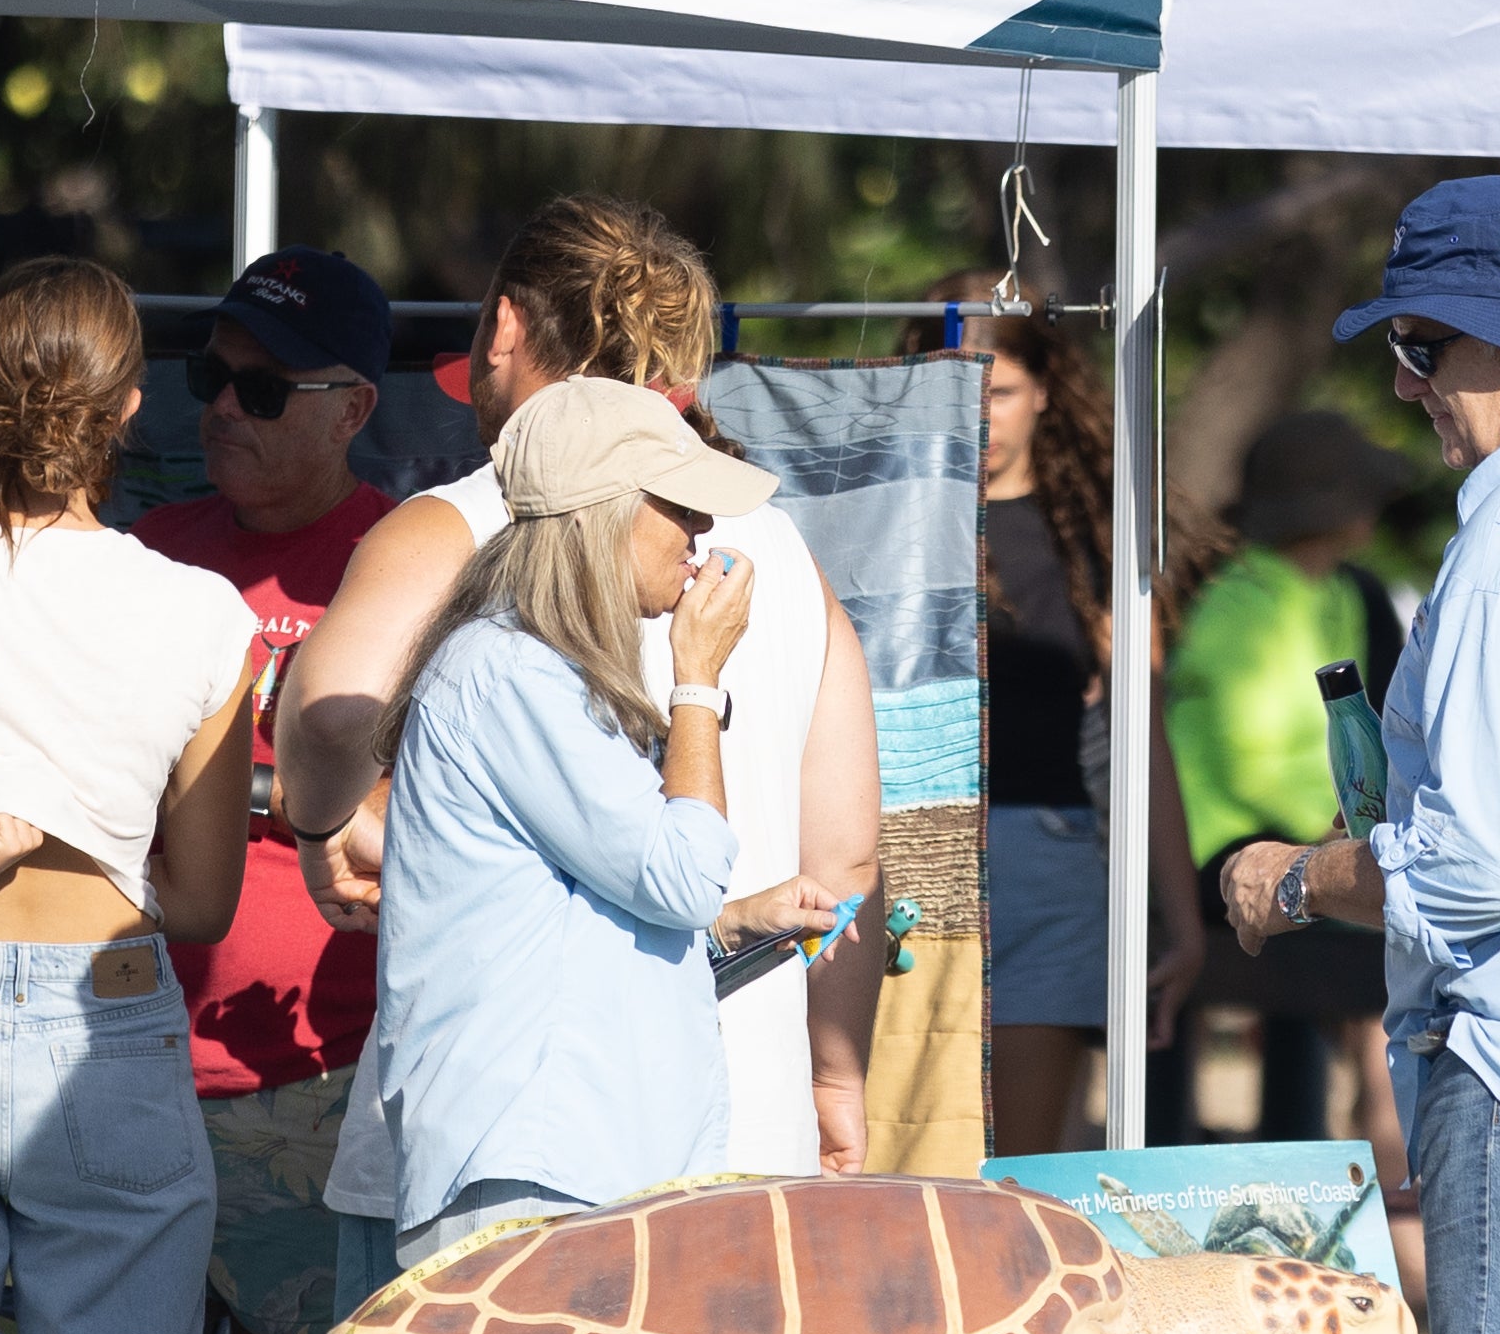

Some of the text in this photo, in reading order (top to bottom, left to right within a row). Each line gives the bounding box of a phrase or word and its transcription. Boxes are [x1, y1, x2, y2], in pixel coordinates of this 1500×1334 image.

[246, 275, 308, 307] BINTANG
[1094, 1188, 1177, 1215] Mariners
[1178, 1186, 1197, 1206] of
[1198, 1184, 1229, 1209] the
[1230, 1181, 1308, 1209] Sunshine
[1309, 1180, 1360, 1204] Coast
